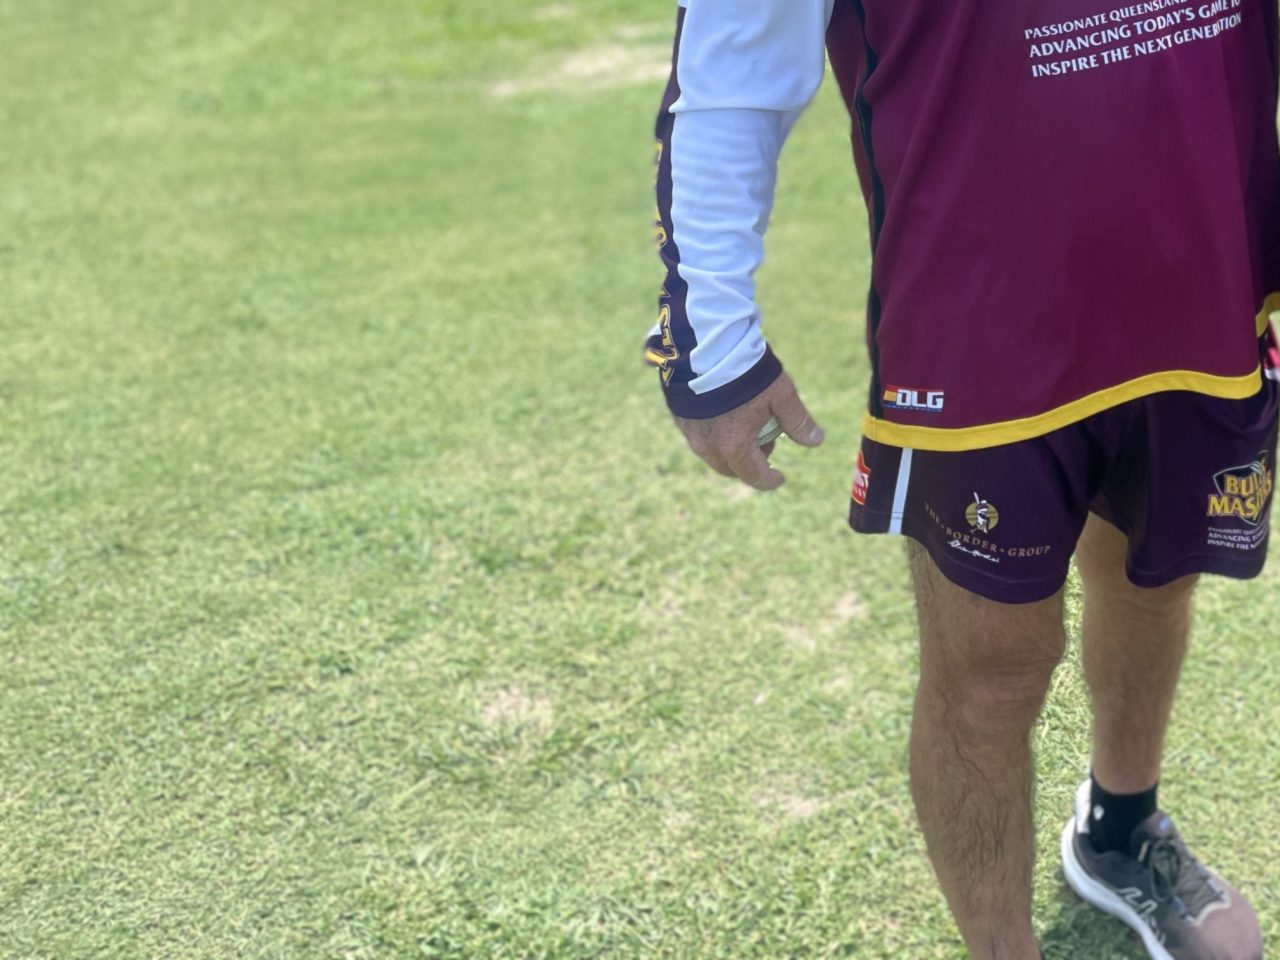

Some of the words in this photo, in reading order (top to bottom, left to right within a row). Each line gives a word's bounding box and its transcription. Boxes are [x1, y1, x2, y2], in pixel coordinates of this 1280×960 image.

[1024, 12, 1109, 40] PASSIONATE
[1029, 24, 1131, 58] ADVANCING
[1133, 7, 1195, 35] TODAY'S
[1198, 0, 1230, 19] GAME
[1031, 54, 1099, 78] INSPIRE
[1101, 46, 1132, 66] THE
[1134, 34, 1173, 57] NEXT
[895, 389, 944, 409] DLG
[924, 501, 941, 525] THE
[945, 527, 997, 553] BORDER
[1007, 545, 1051, 558] GROUP
